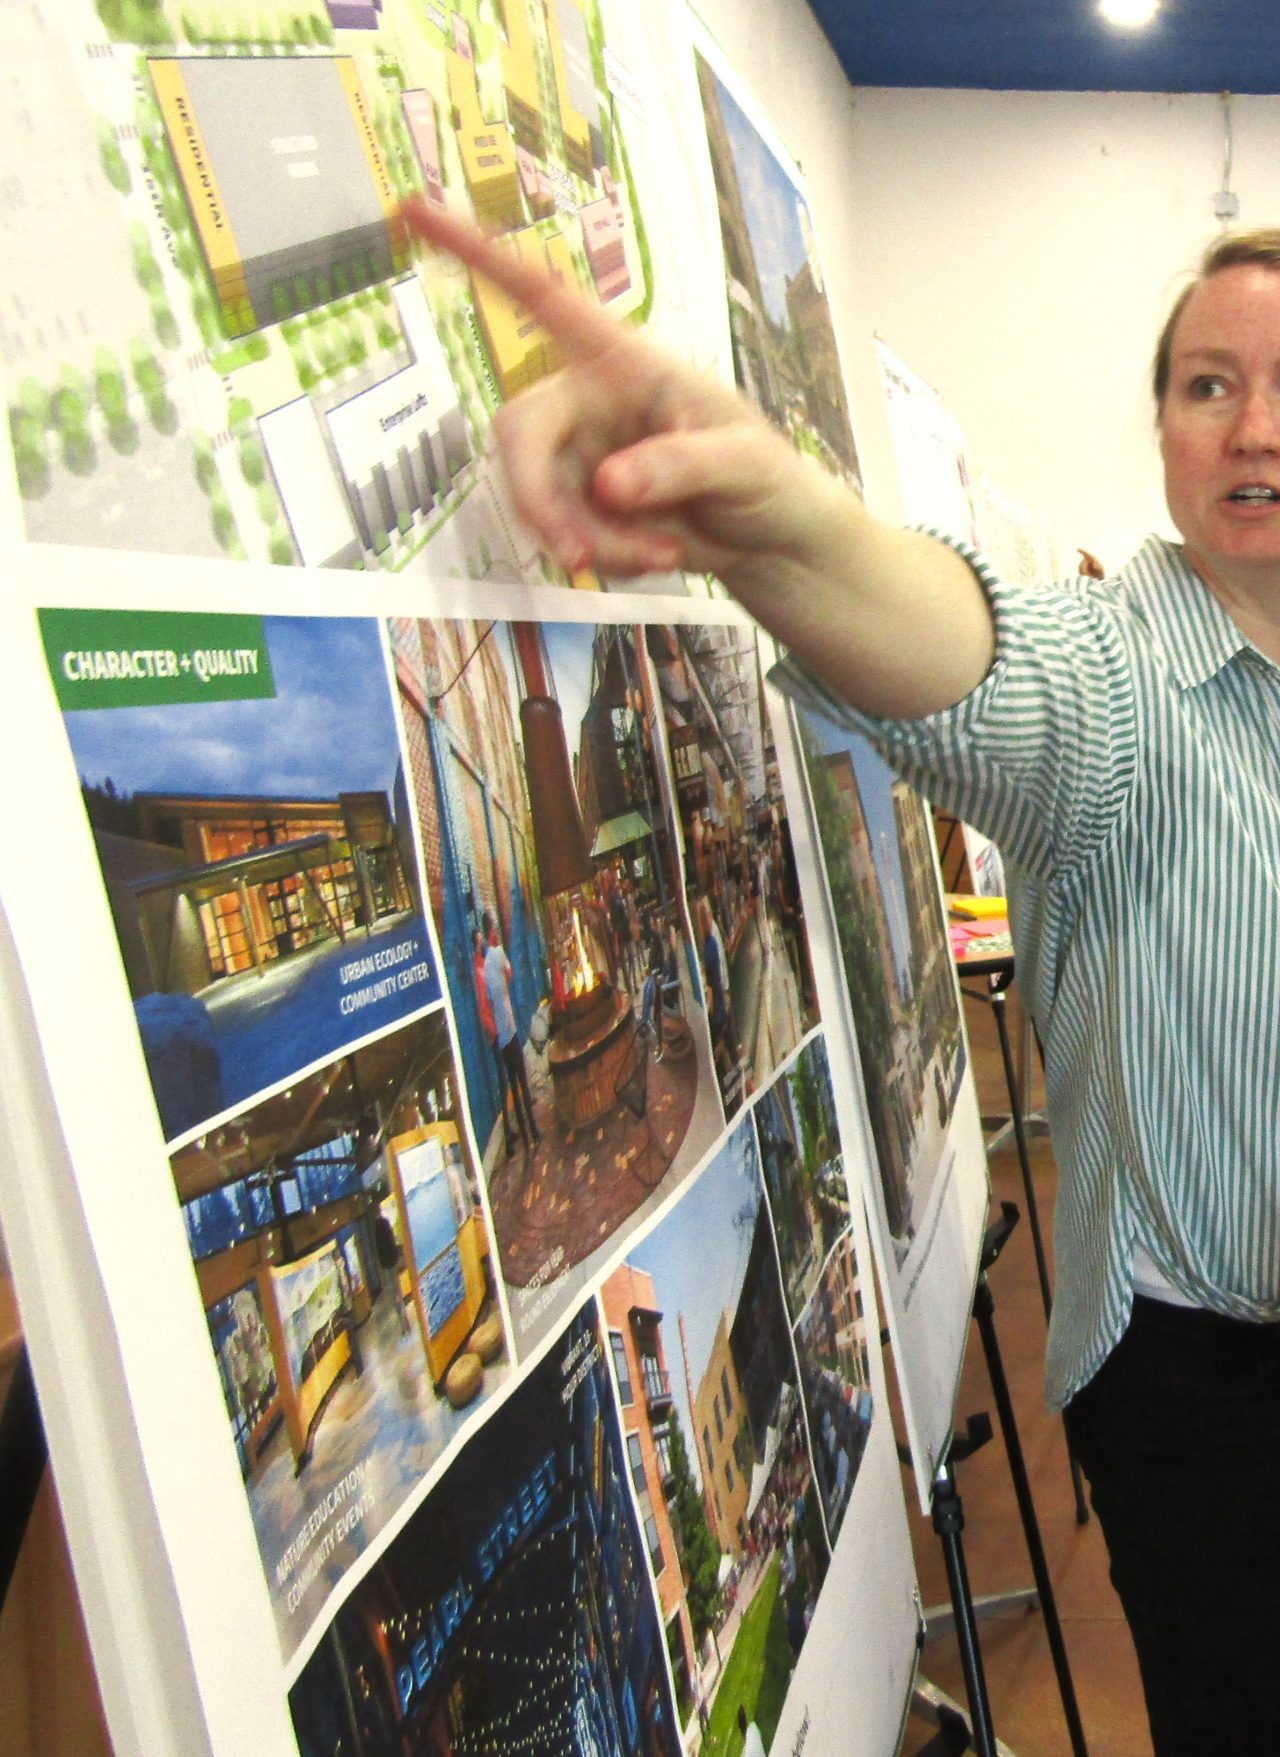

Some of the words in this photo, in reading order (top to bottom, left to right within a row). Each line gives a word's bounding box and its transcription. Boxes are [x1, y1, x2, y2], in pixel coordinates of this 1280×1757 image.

[63, 650, 180, 682] CHARACTER
[193, 649, 259, 683] QUALITY
[340, 956, 375, 985] URBAN
[374, 940, 413, 971] ECOLOGY
[340, 975, 397, 1015] COMMUNITY
[398, 961, 430, 990] CENTER
[395, 1574, 474, 1715] PEARL
[476, 1450, 557, 1582] STREET
